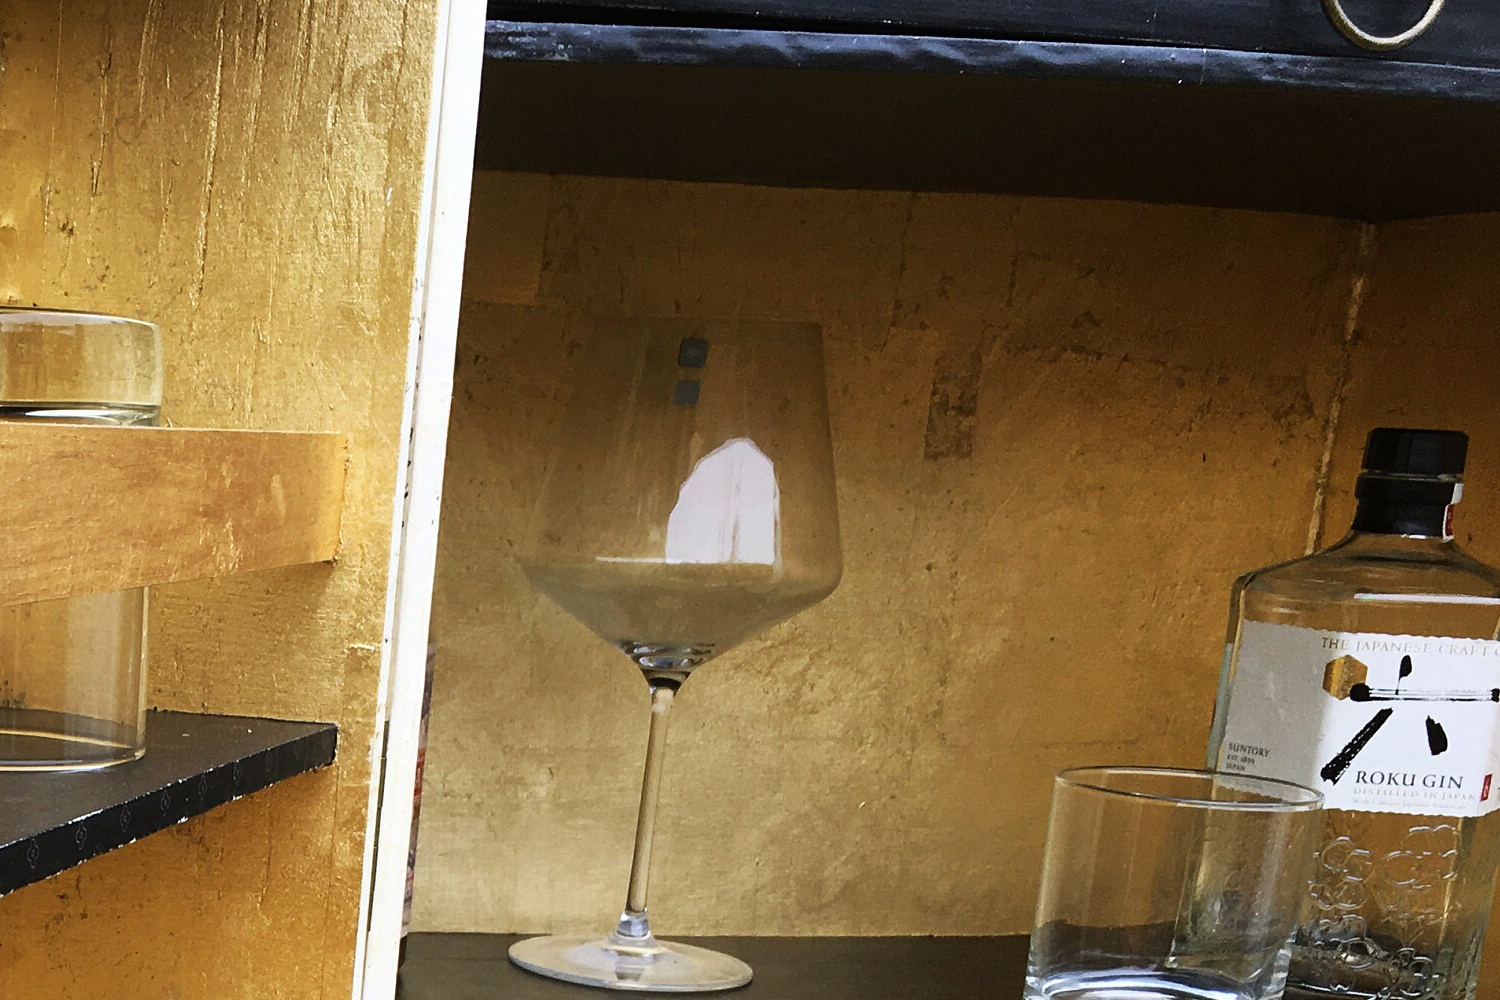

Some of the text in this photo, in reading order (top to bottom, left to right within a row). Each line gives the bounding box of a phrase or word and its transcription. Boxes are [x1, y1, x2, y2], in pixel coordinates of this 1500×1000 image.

[1320, 636, 1350, 651] THE
[1355, 640, 1433, 654] JAPANESE
[1437, 644, 1491, 657] CRAFT
[1228, 742, 1270, 758] SUNTORY
[1355, 770, 1416, 787] ROKU
[1422, 774, 1464, 790] GIN
